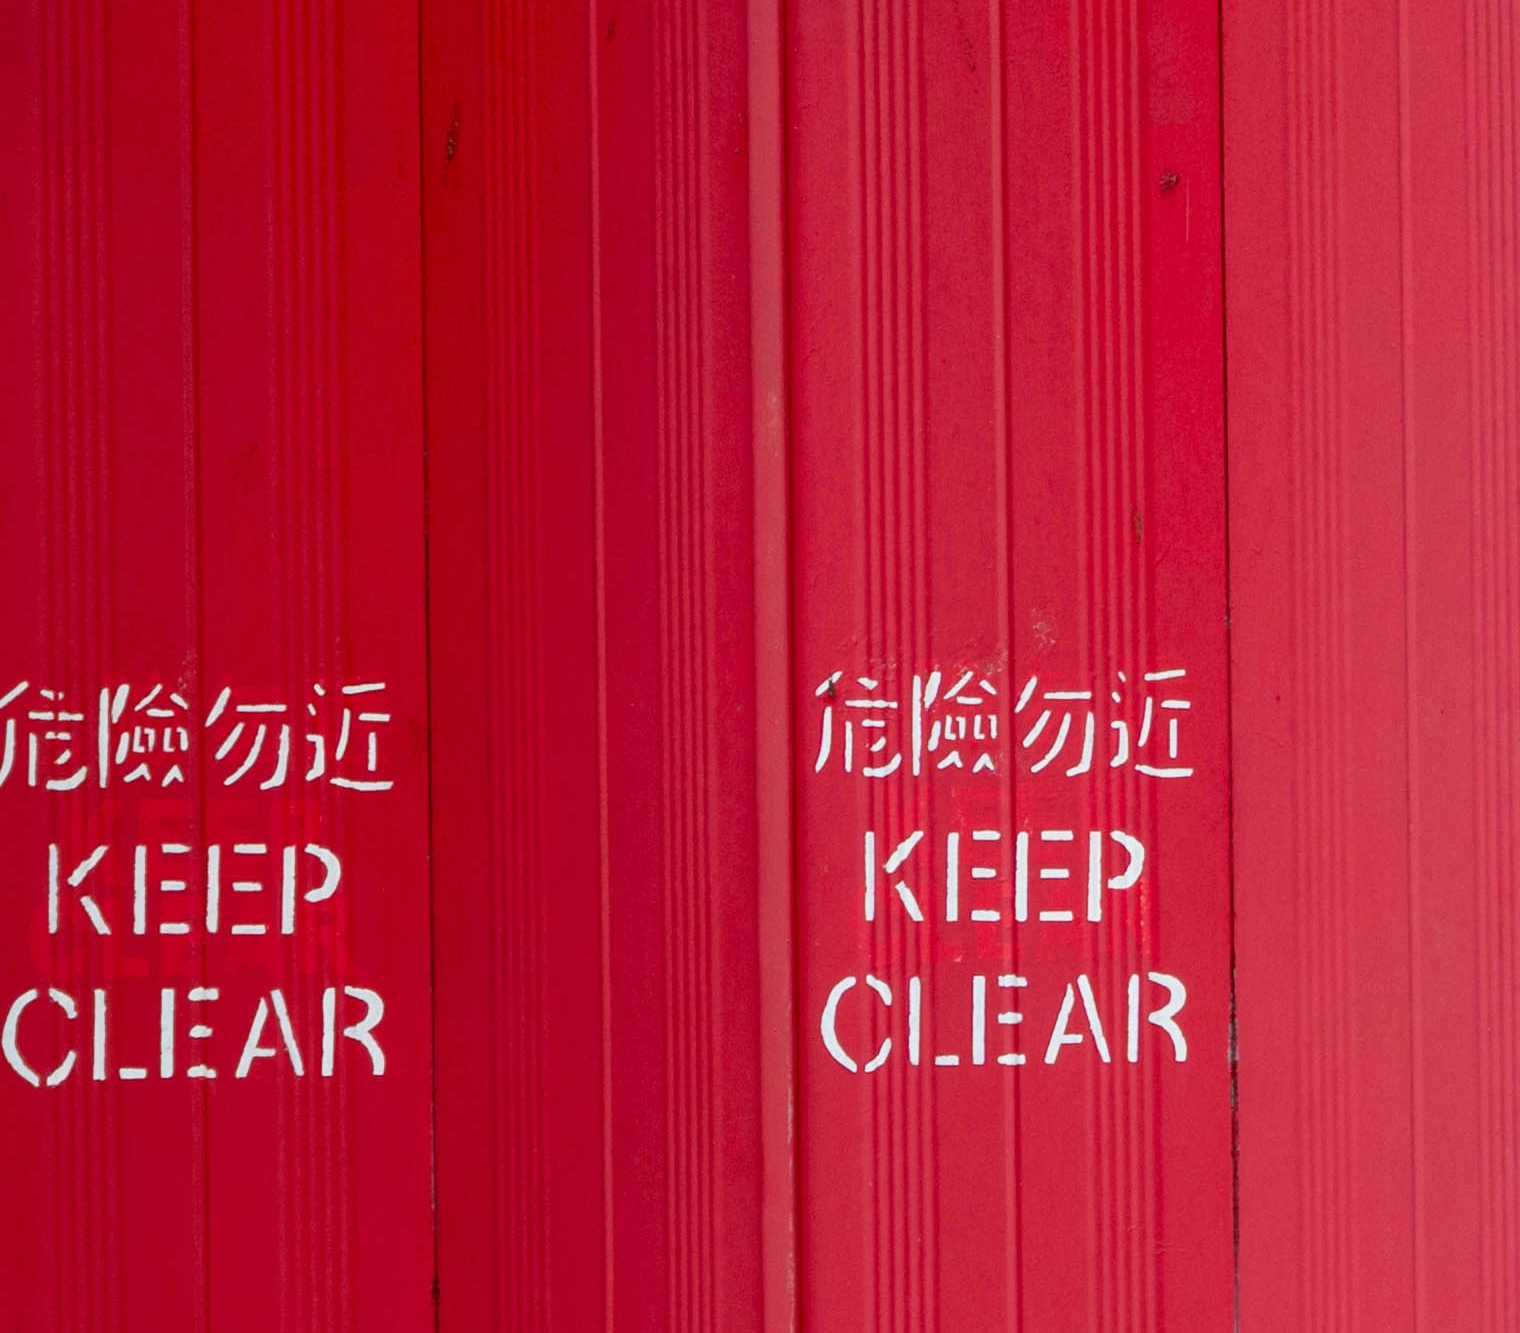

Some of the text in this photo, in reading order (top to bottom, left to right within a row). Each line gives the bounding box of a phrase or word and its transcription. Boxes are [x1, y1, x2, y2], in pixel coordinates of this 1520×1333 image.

[0, 682, 393, 790] 危險勿近
[815, 669, 1193, 778] 危險勿近
[49, 844, 341, 934] KEEP
[865, 830, 1145, 922] KEEP
[2, 986, 385, 1087] CLEAR
[821, 972, 1187, 1072] CLEAR
